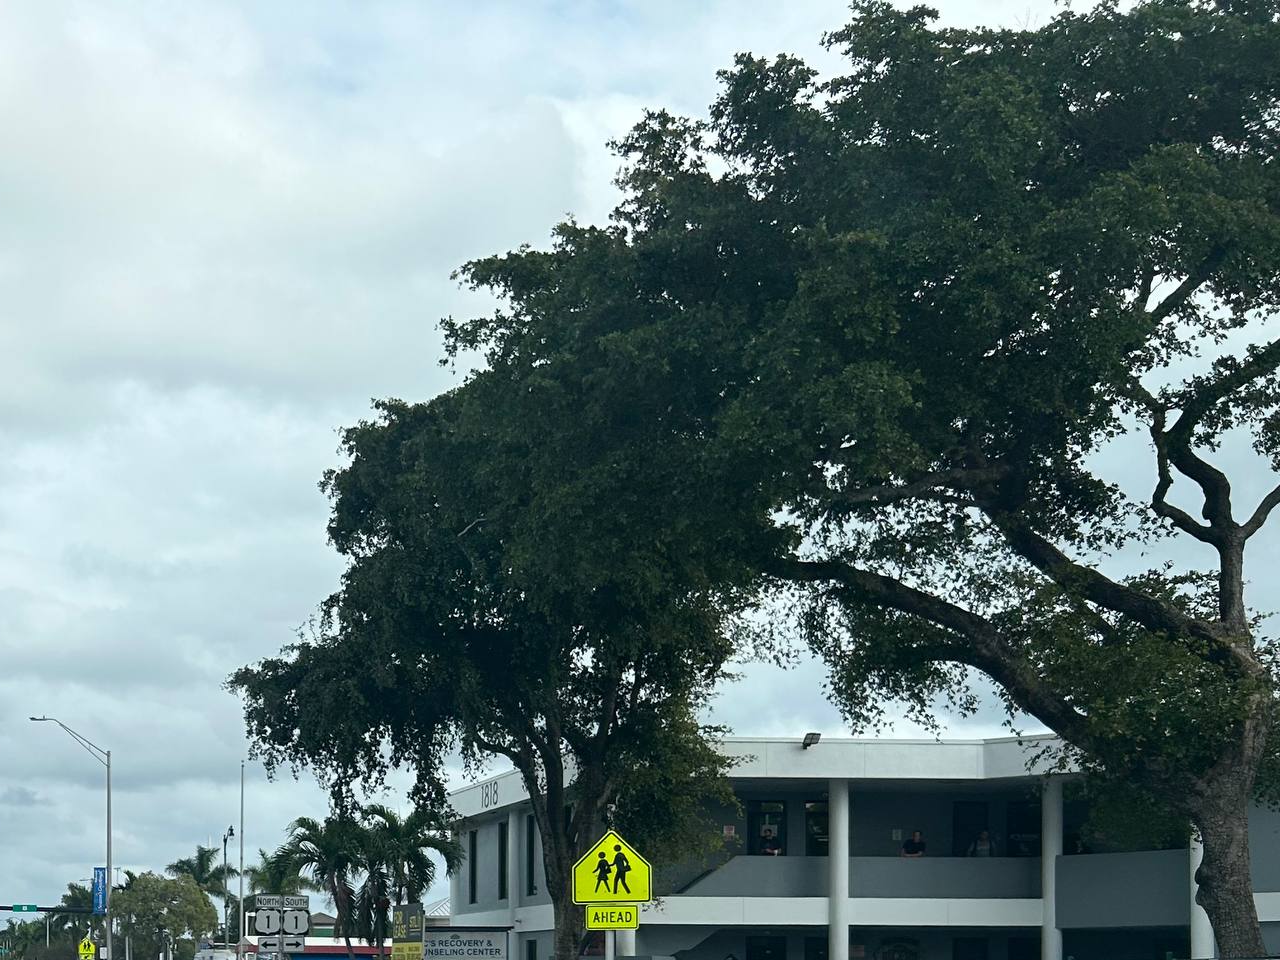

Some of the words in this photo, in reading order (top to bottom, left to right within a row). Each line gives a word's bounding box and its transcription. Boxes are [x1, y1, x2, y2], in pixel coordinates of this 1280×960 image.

[481, 781, 498, 808] 1818
[256, 896, 280, 906] NORTH
[285, 897, 308, 906] SOUTH
[265, 915, 271, 929] 1
[294, 915, 299, 929] 1
[593, 911, 632, 923] AHEAD
[466, 948, 501, 956] CENTER
